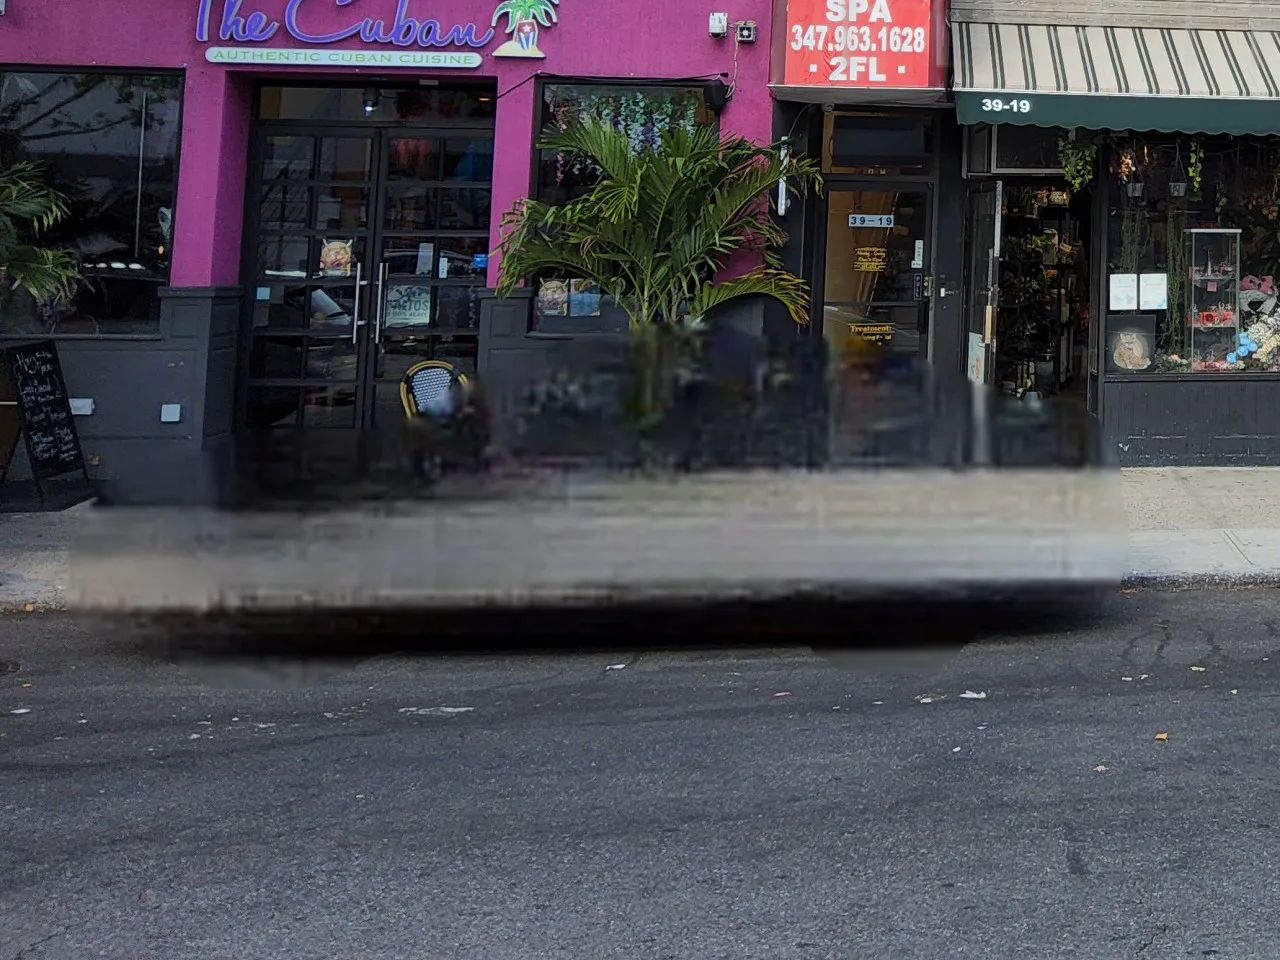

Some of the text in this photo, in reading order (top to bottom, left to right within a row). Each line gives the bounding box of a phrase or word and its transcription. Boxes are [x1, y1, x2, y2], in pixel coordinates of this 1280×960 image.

[790, 24, 925, 53] 347.963.1628
[213, 50, 476, 65] AUTHENTIC CUBAN CUISINE
[981, 98, 1031, 114] 39-19
[850, 216, 893, 226] 39-19
